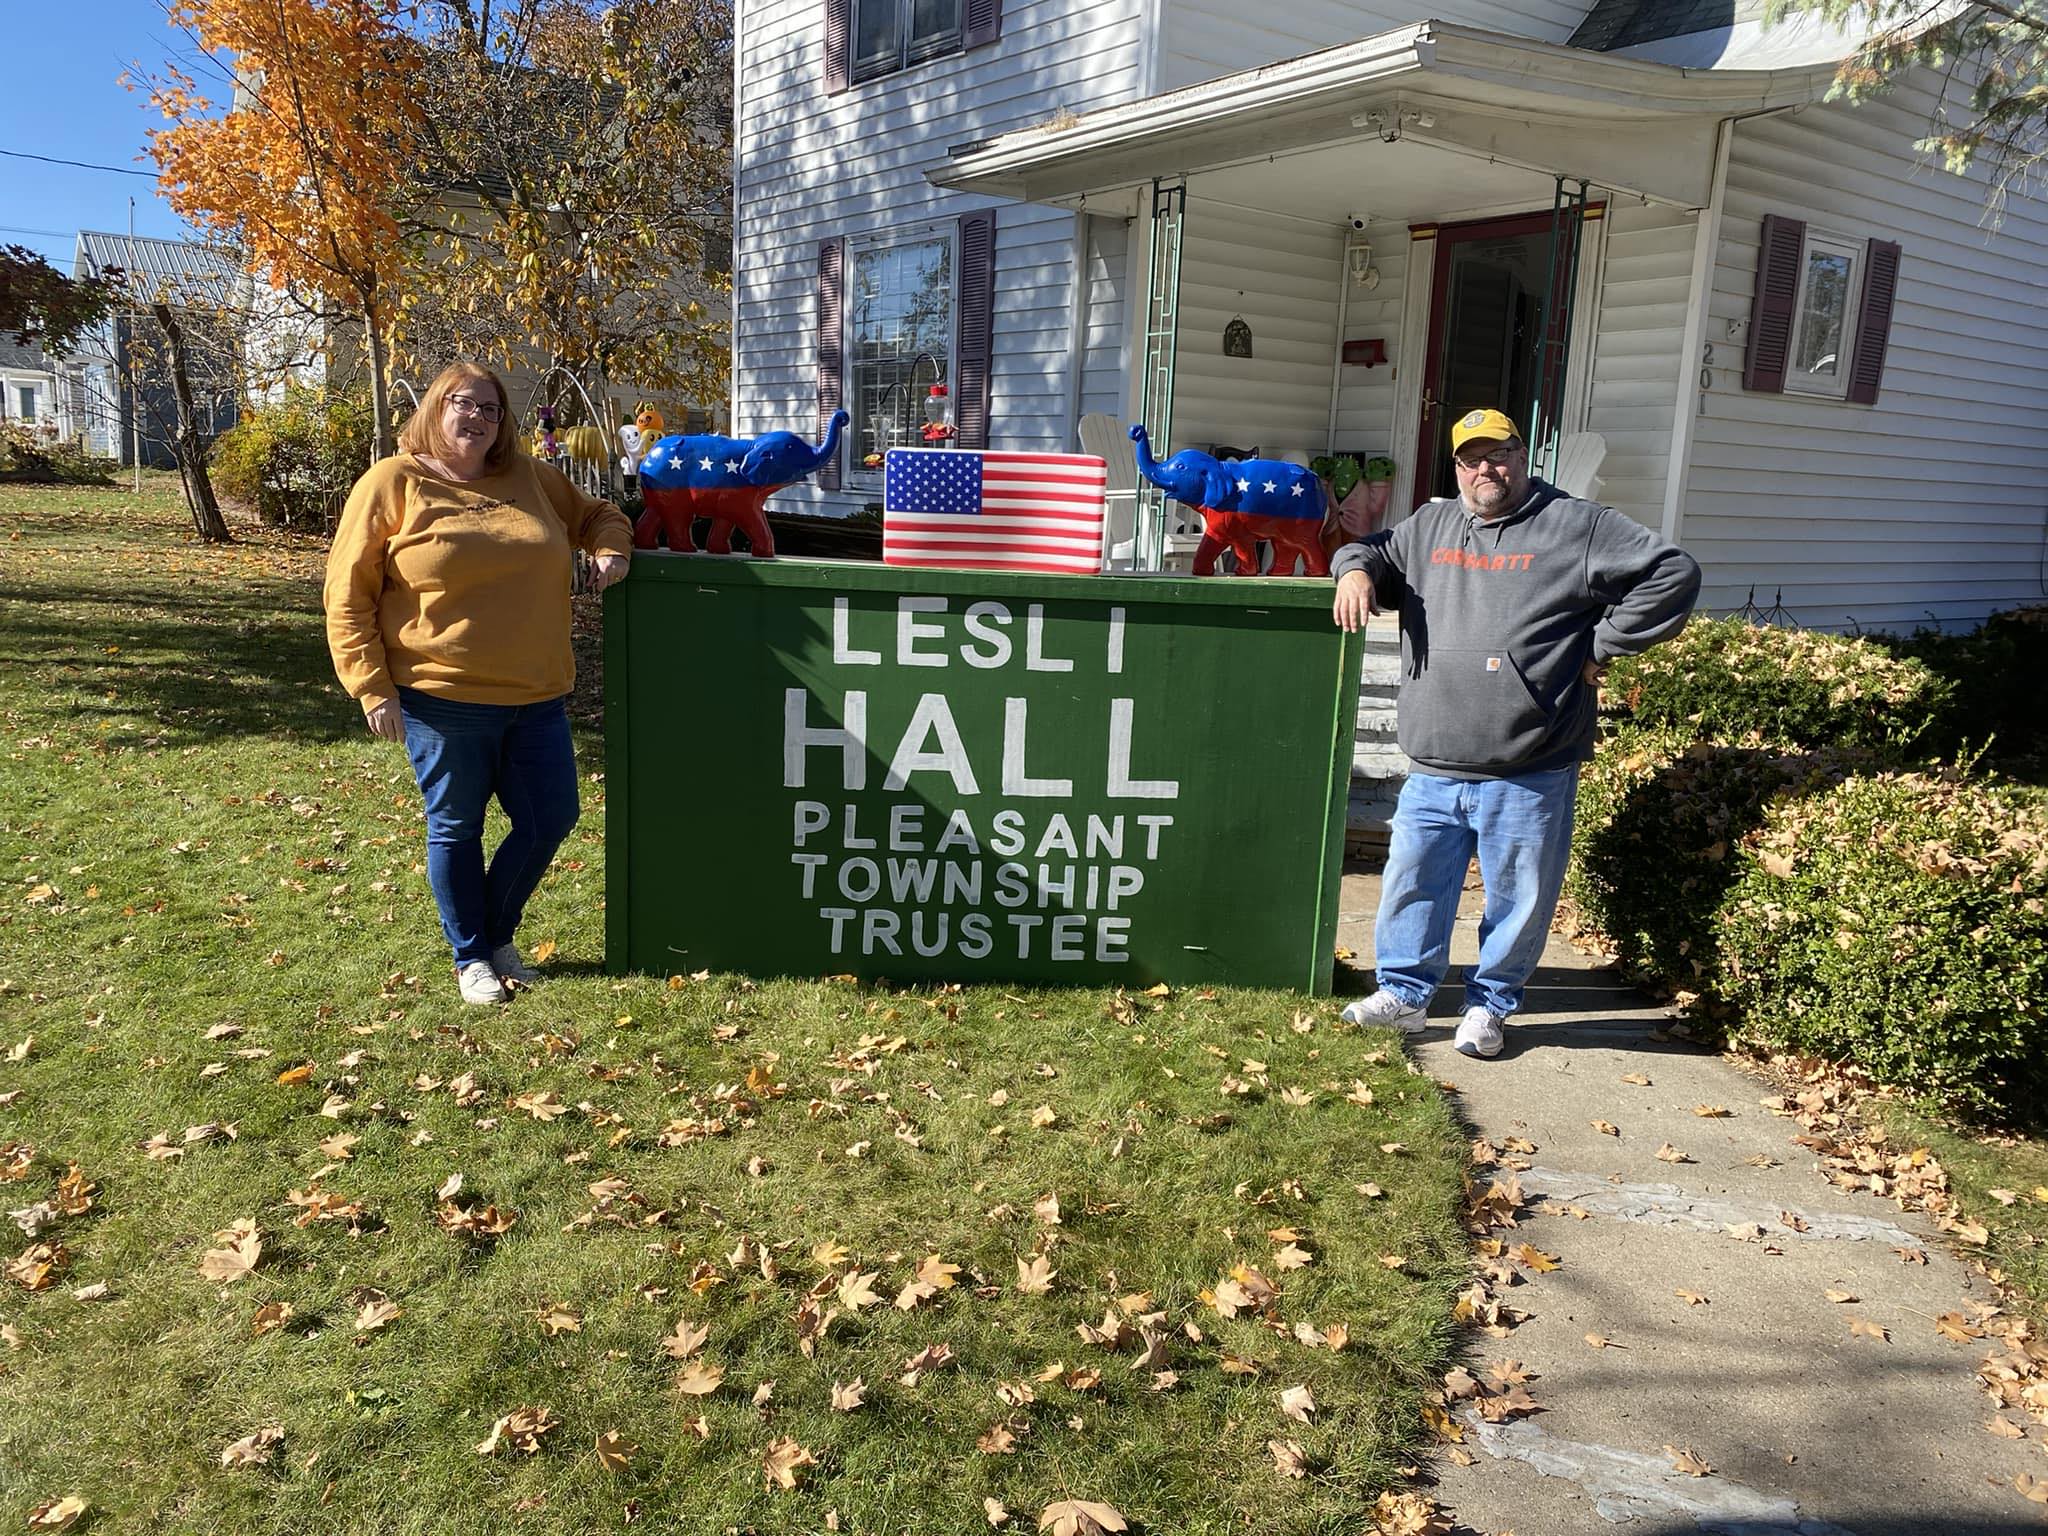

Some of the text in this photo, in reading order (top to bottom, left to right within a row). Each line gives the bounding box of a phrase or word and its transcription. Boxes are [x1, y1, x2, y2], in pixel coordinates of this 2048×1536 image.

[832, 596, 1125, 674] LESLI
[783, 688, 1180, 801] HALL
[793, 800, 1175, 861] PLEASANT
[791, 853, 1145, 911] TOWNSHIP
[819, 907, 1132, 962] TRUSTEE
